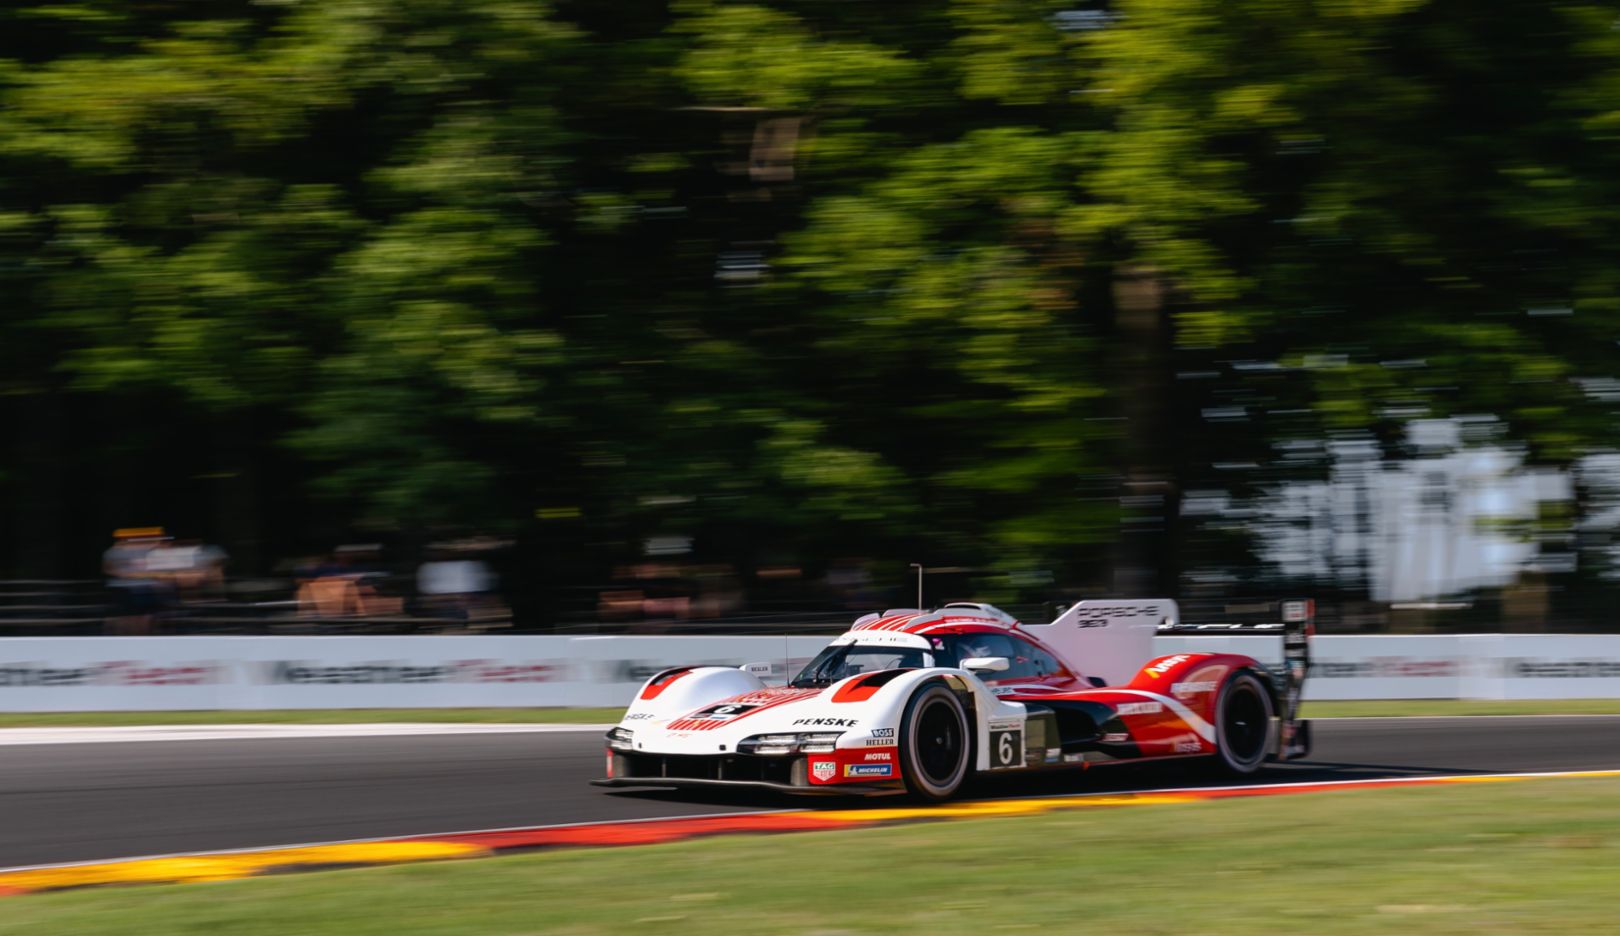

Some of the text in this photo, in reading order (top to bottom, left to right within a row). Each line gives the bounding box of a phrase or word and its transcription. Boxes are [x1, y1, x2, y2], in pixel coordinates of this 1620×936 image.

[792, 717, 860, 727] PENSKE
[873, 728, 893, 737] BOSS
[998, 732, 1014, 765] 6
[815, 762, 835, 770] TAG
